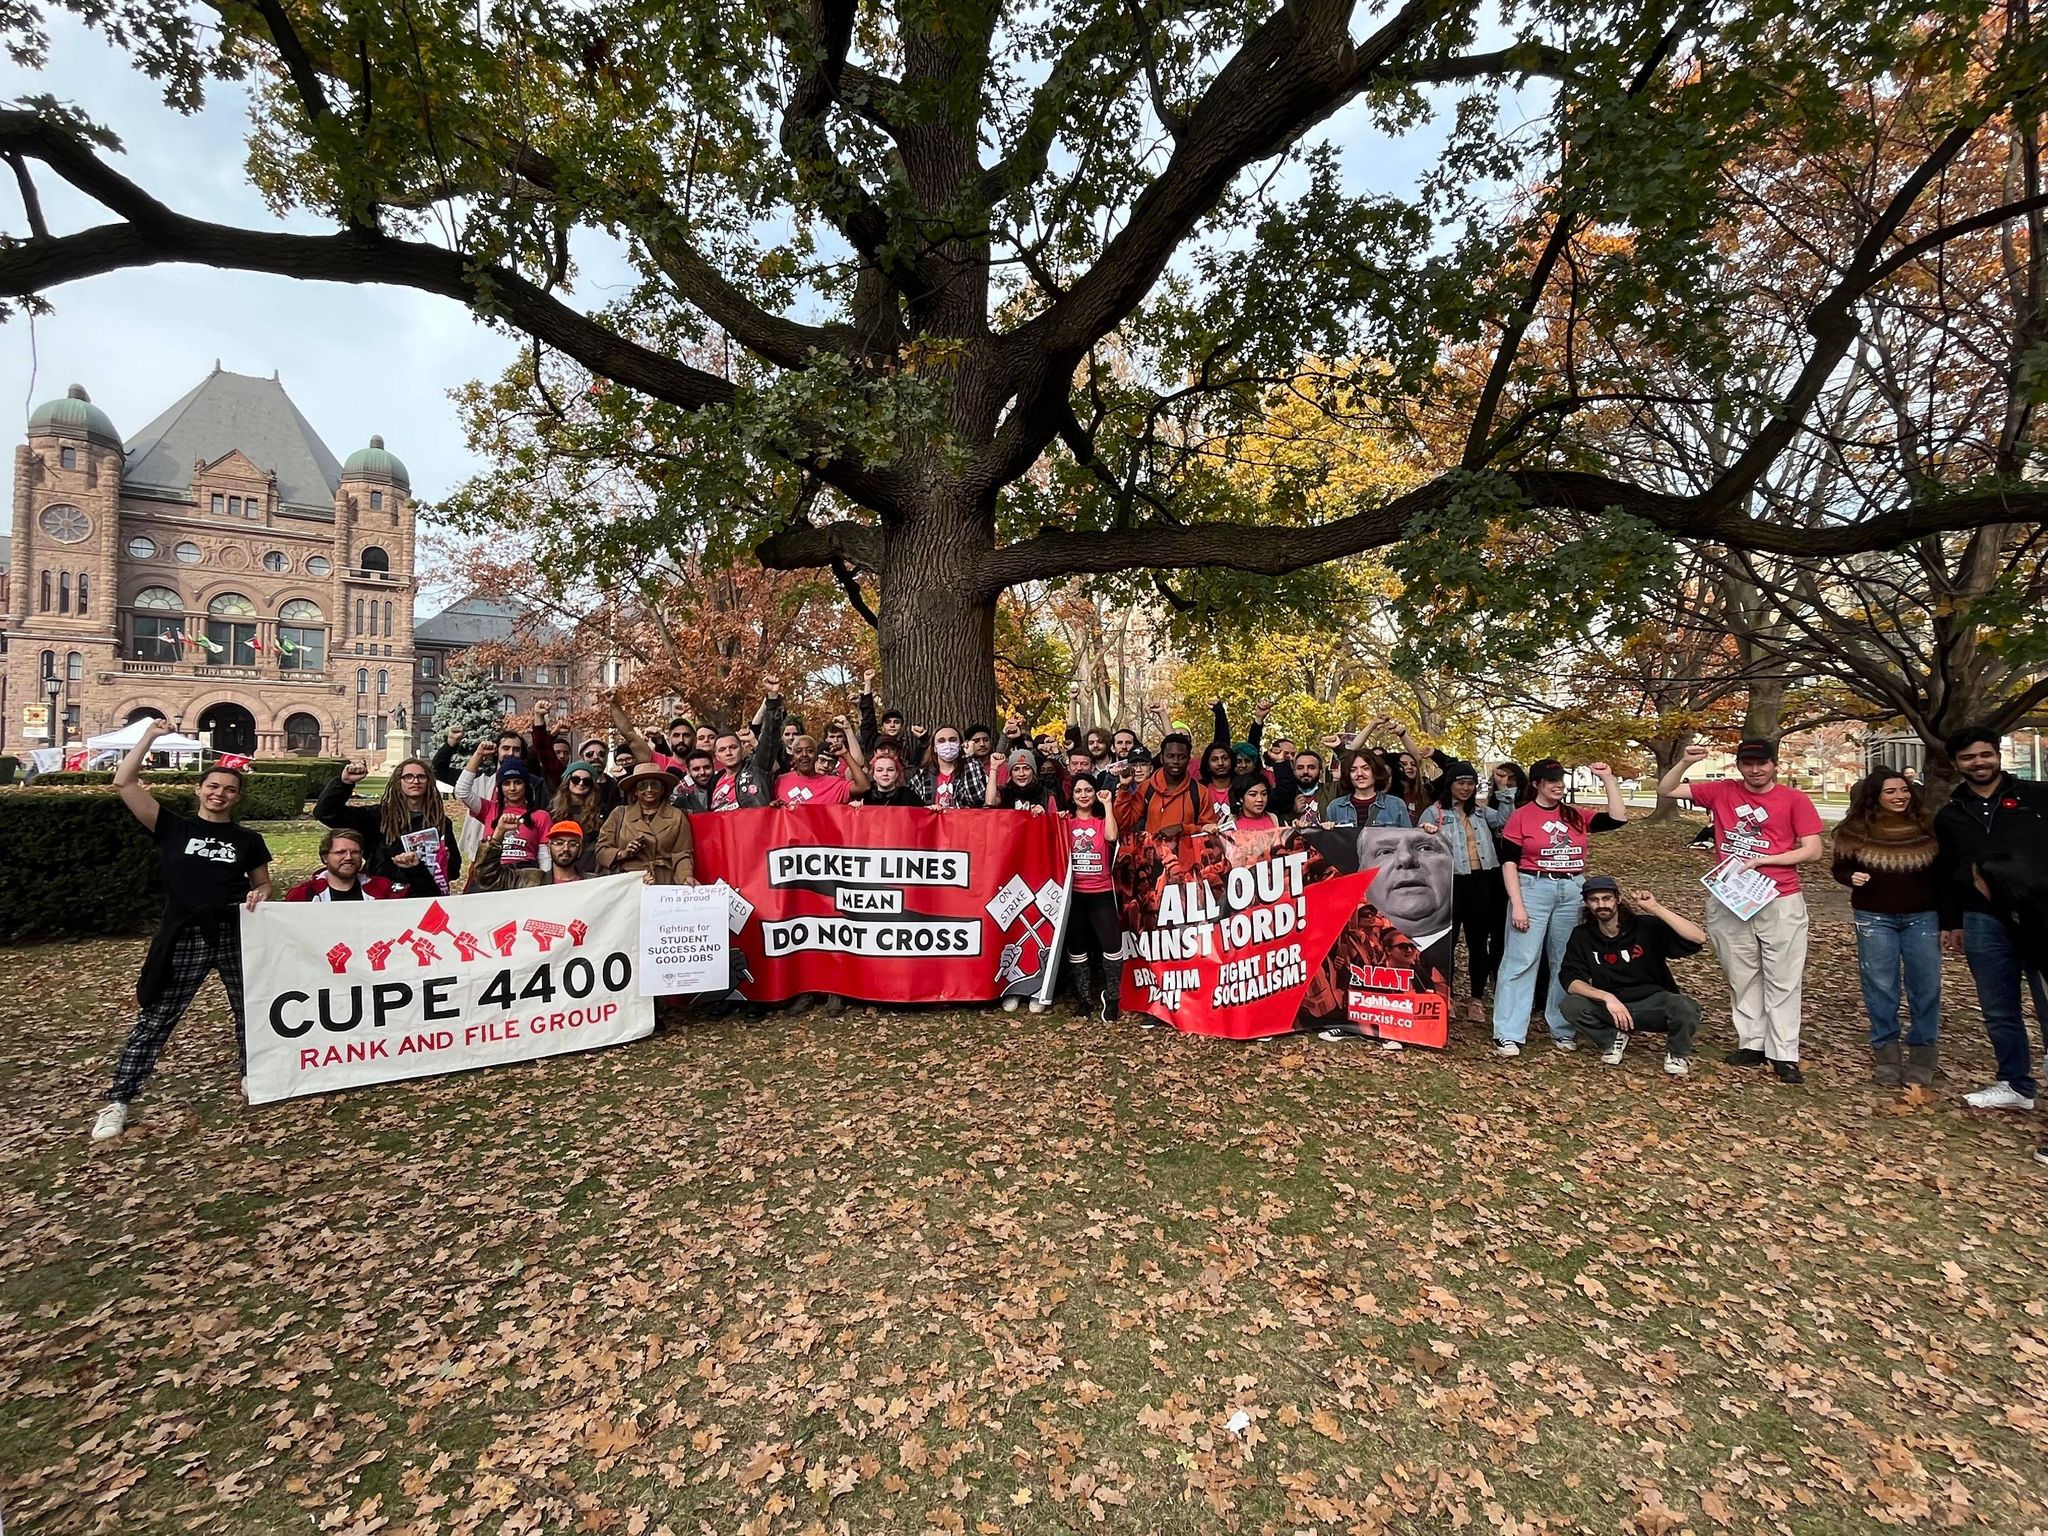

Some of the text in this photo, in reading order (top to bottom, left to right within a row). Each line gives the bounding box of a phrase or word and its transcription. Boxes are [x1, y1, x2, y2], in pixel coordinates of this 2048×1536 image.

[779, 854, 957, 880] PICKET LINES
[660, 895, 674, 903] I'm
[683, 894, 711, 904] proud
[998, 888, 1012, 904] ON
[1157, 851, 1307, 927] ALL OUT
[842, 893, 894, 910] MEAN
[1000, 889, 1028, 923] STRIKE
[659, 924, 710, 934] fighting for
[1219, 896, 1307, 951] FORD!
[660, 935, 709, 945] STUDENT
[772, 923, 969, 951] DO NOT CROSS
[647, 944, 721, 955] SUCCESS AND
[655, 954, 714, 965] GOOD JOBS
[1219, 943, 1301, 985] FIGHT FOR
[1162, 968, 1201, 991] HIM
[1212, 960, 1307, 1008] SOCIALISM!
[1363, 965, 1414, 991] IMT
[269, 951, 633, 1038] CUPE 4400
[1348, 991, 1414, 1011] Fightback
[1349, 1011, 1413, 1029] marxist.ca
[299, 1003, 618, 1070] RANK AND FILE GROUP
